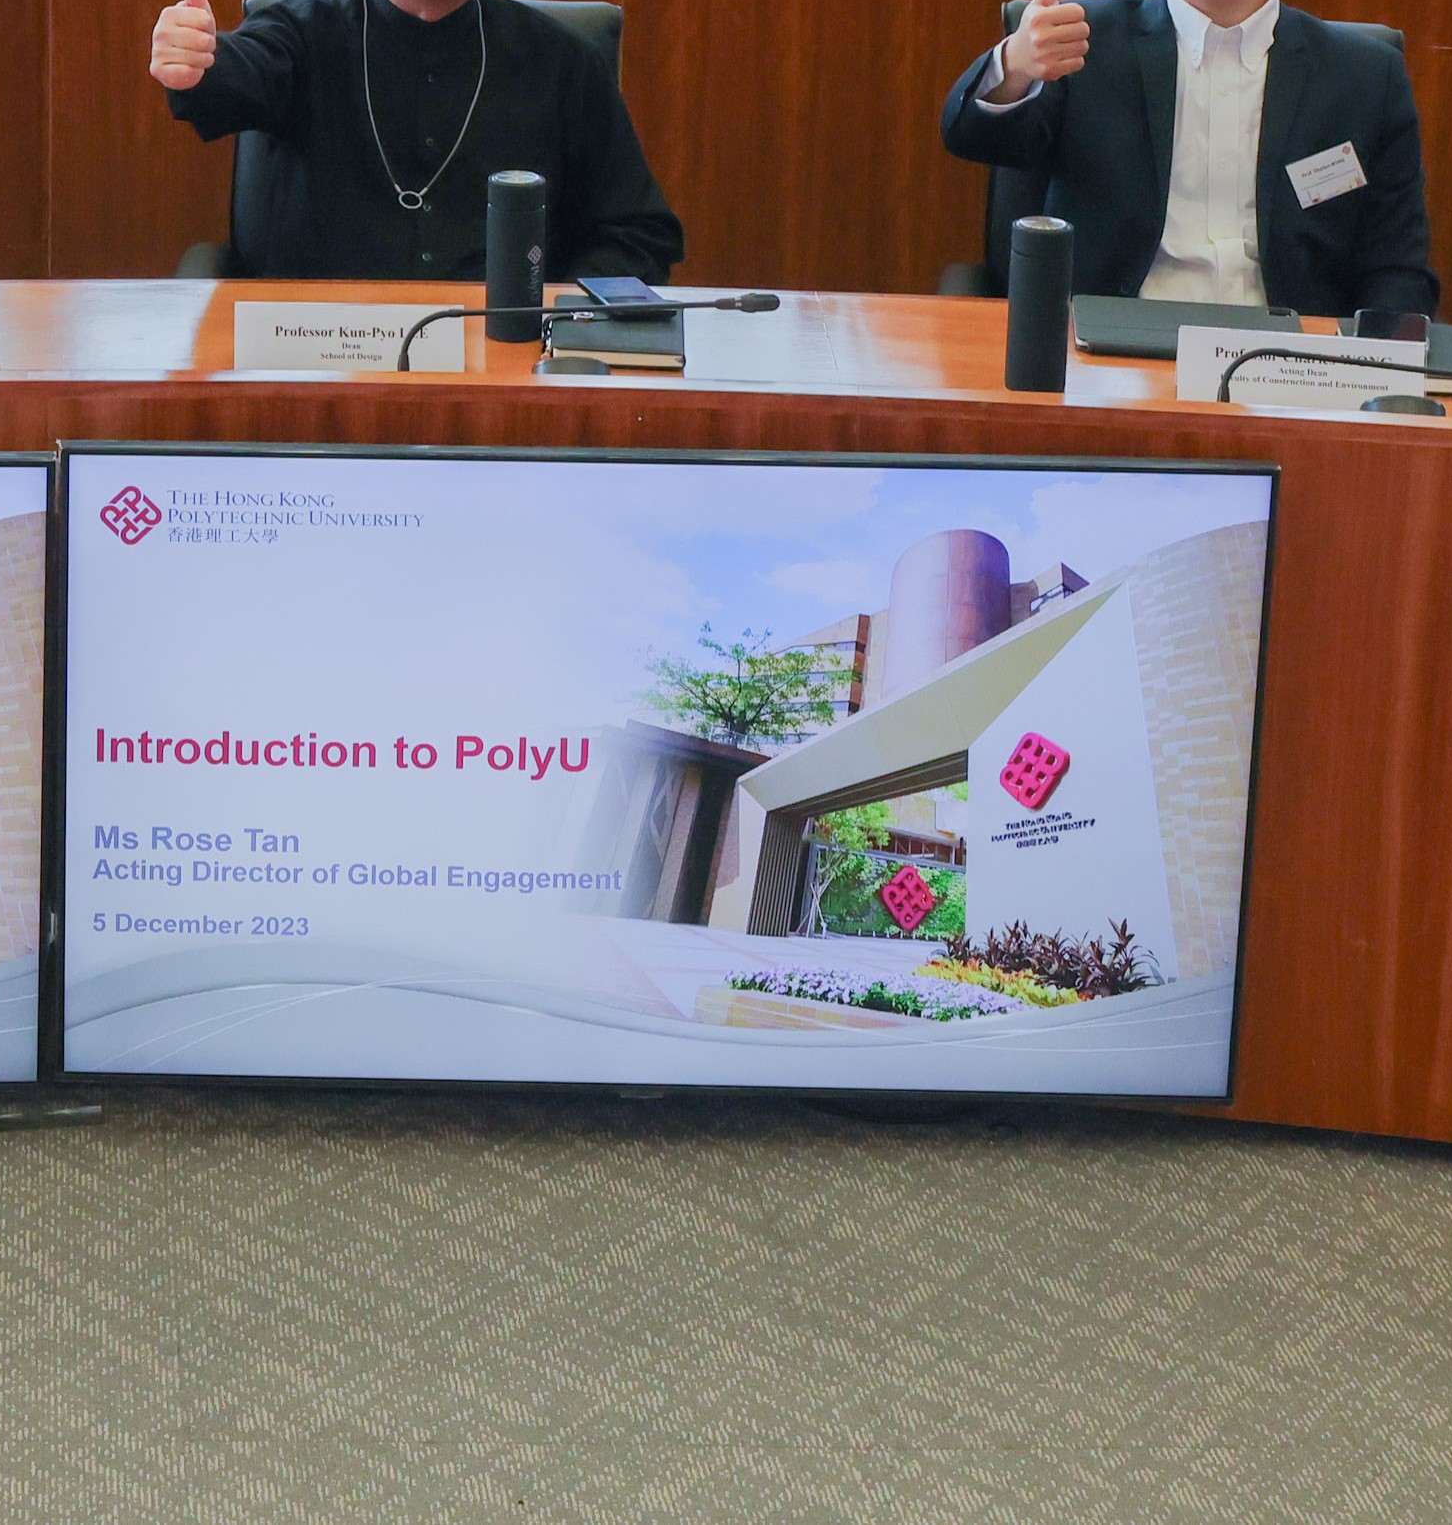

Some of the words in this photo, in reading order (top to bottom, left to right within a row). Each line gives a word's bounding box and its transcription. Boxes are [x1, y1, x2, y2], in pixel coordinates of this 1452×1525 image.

[275, 326, 334, 338] Professor
[339, 326, 395, 341] Kun-Pyo
[400, 326, 429, 339] LE
[357, 353, 382, 361] Design
[1278, 367, 1305, 376] Acting
[1262, 377, 1316, 386] Construction
[1335, 381, 1389, 391] Environment
[167, 489, 209, 507] THE
[214, 490, 274, 508] HONG
[278, 491, 335, 509] KONG
[167, 508, 305, 526] POLYTECHNIC
[308, 510, 425, 529] UNIVERSITY
[167, 526, 279, 545] 香港理工大學
[95, 728, 377, 769] Introduction
[394, 733, 438, 770] to
[455, 735, 591, 780] PolyU
[93, 825, 139, 851] Ms
[151, 827, 233, 852] Rose
[244, 828, 301, 854] Tan
[93, 859, 183, 887] Acting
[192, 860, 304, 885] Director
[312, 863, 340, 886] of
[347, 863, 438, 888] Global
[446, 865, 623, 893] Engagement
[93, 912, 107, 933] 5
[115, 913, 243, 935] December
[250, 915, 309, 936] 2023
